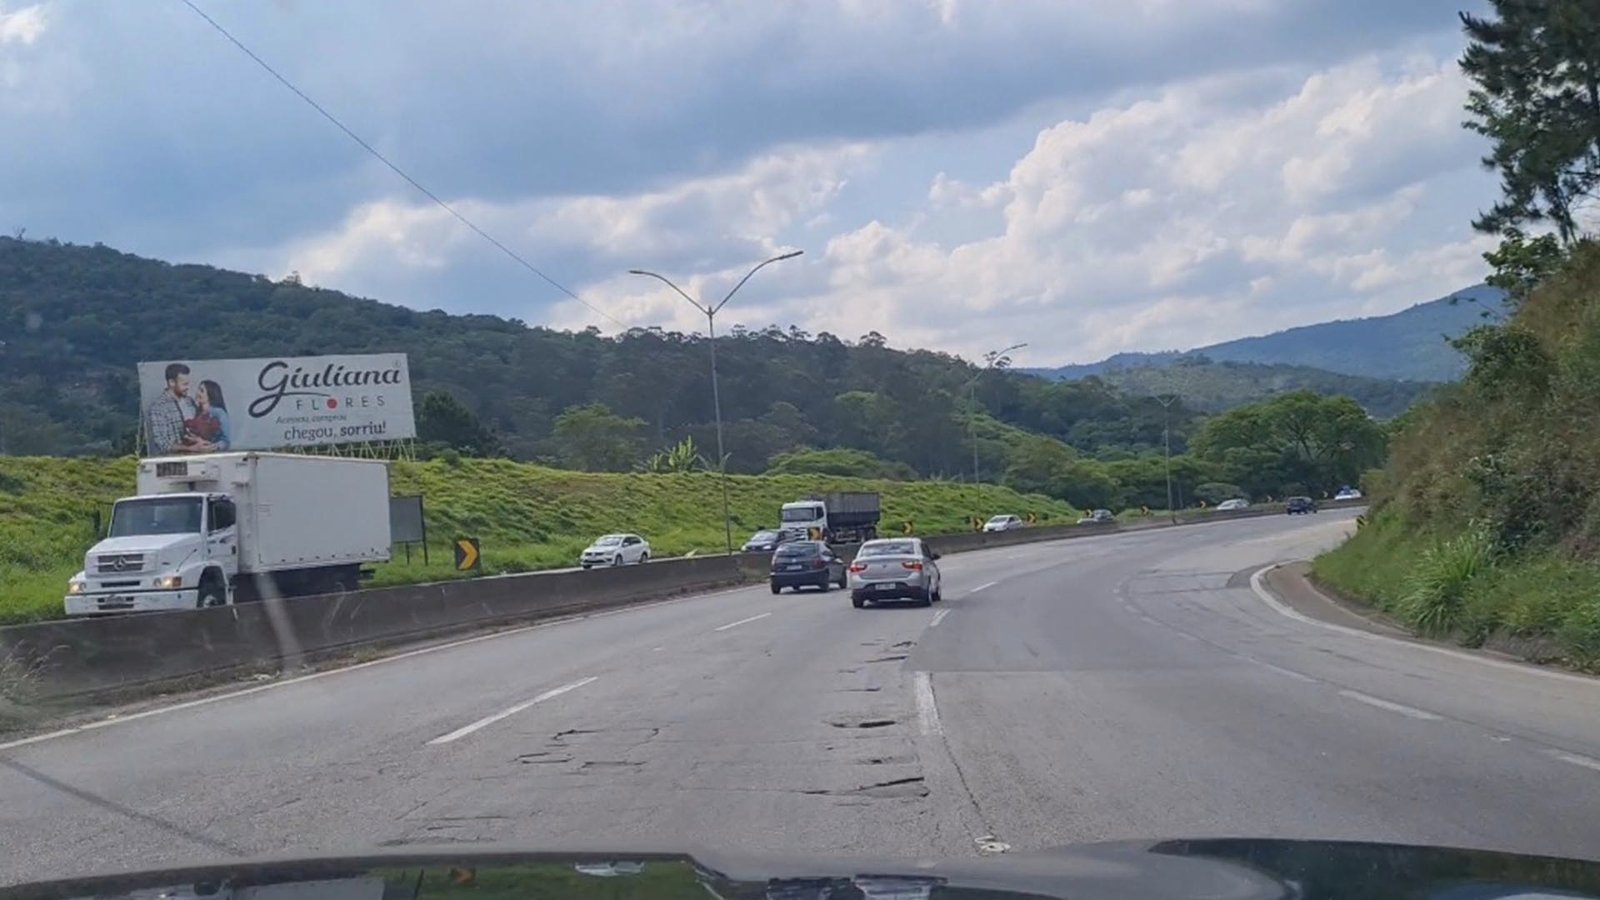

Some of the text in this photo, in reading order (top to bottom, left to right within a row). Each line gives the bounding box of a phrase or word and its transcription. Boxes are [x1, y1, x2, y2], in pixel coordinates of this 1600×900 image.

[248, 361, 401, 418] Giuliana
[296, 396, 386, 410] FLORES
[284, 421, 386, 441] chegou, sorriu!
